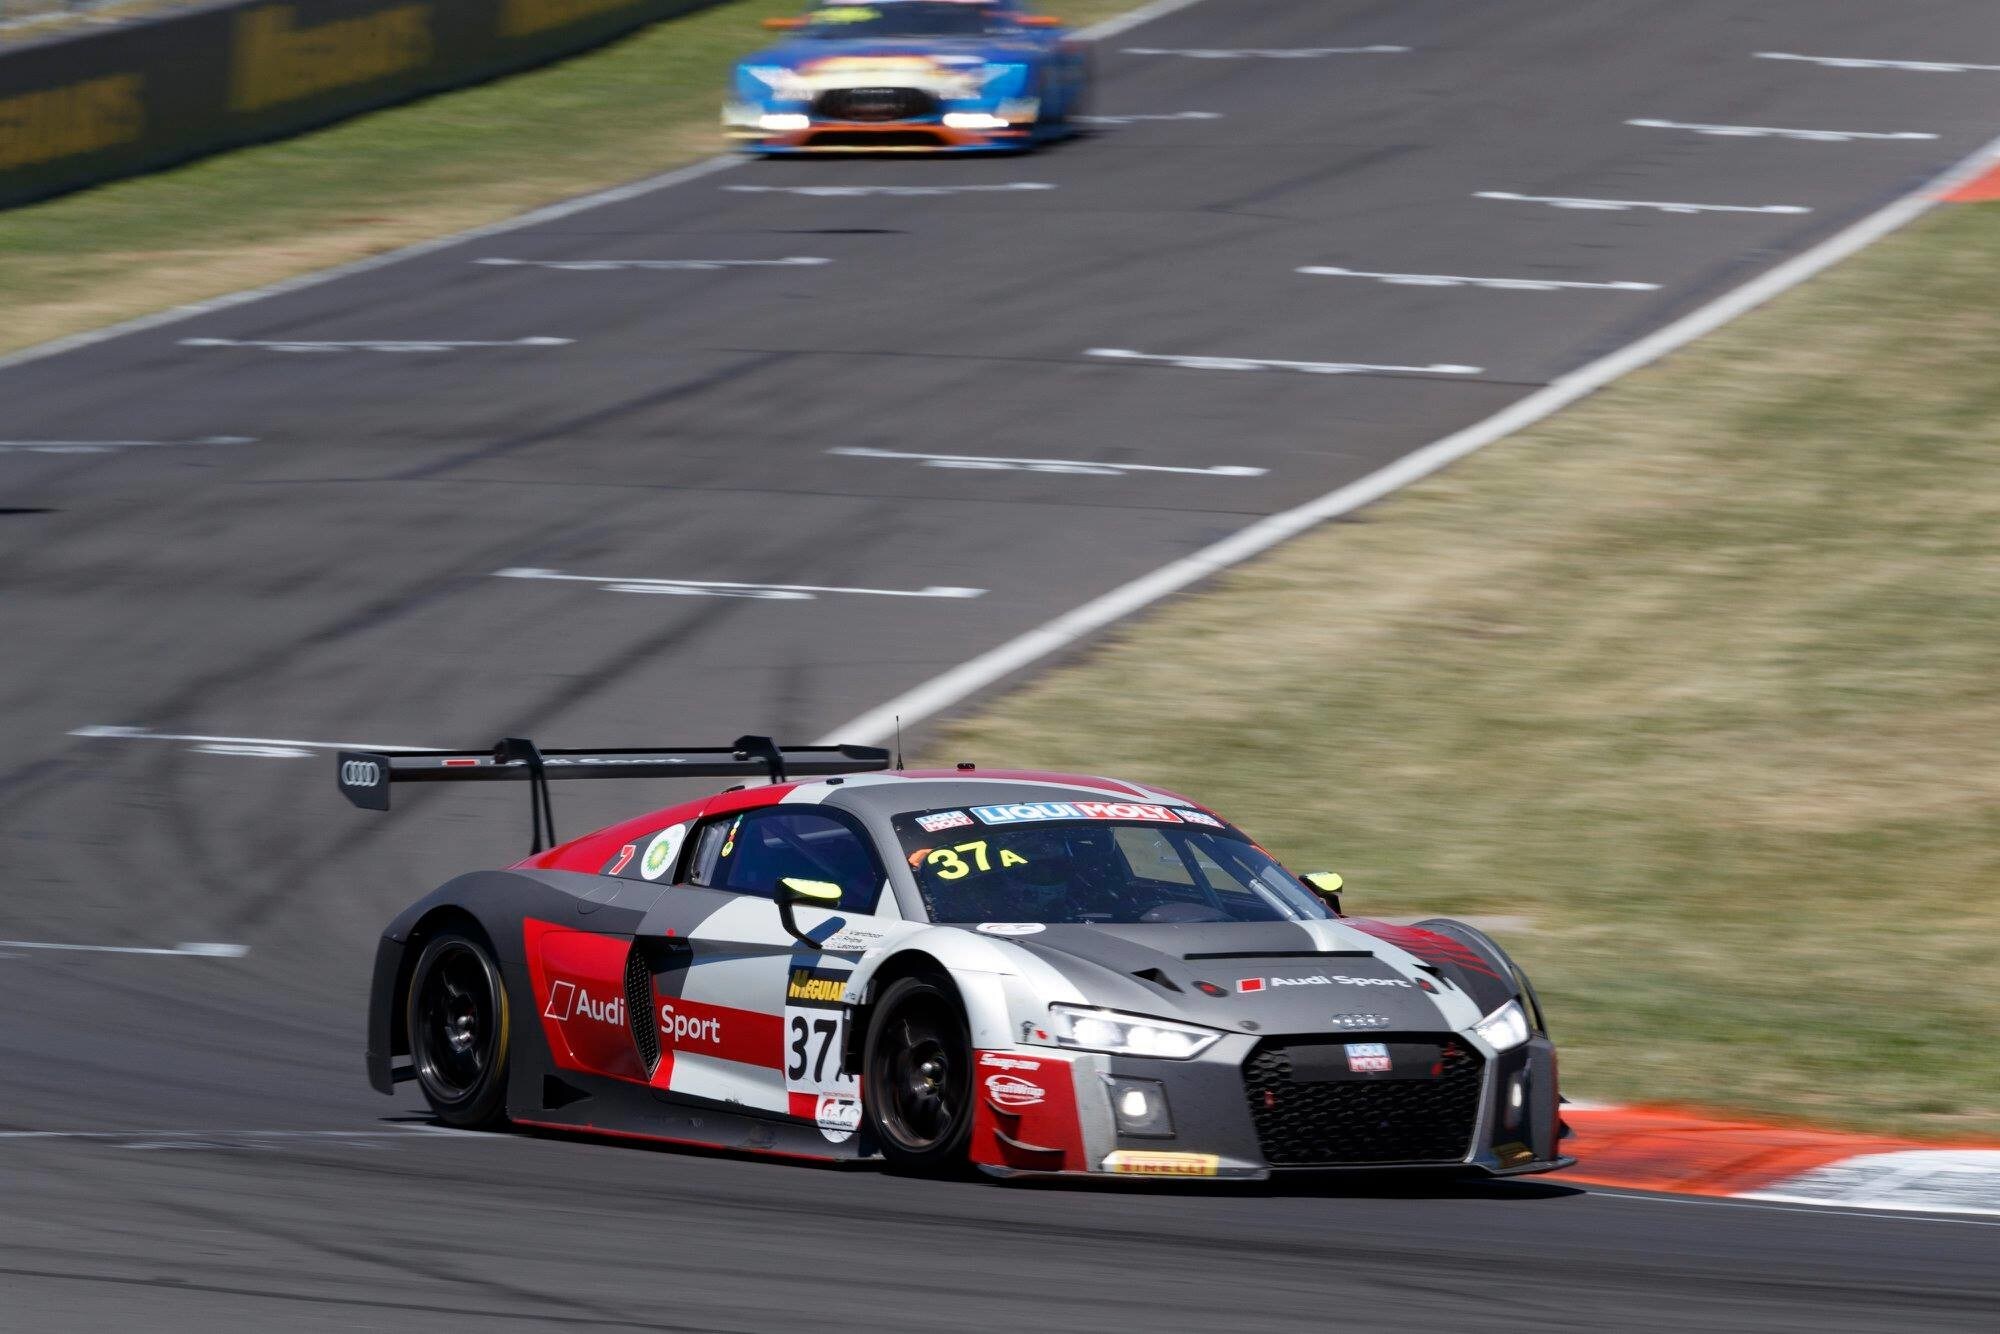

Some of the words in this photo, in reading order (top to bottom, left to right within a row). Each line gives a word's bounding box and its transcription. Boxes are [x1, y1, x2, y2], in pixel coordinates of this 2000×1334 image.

[979, 803, 1082, 822] LIQUI
[1082, 802, 1171, 820] MOLY
[1271, 975, 1332, 987] Audi
[1333, 975, 1412, 988] Sport
[576, 989, 625, 1027] Audi
[661, 1004, 720, 1043] Sport
[1120, 1156, 1207, 1174] PIRELLI
